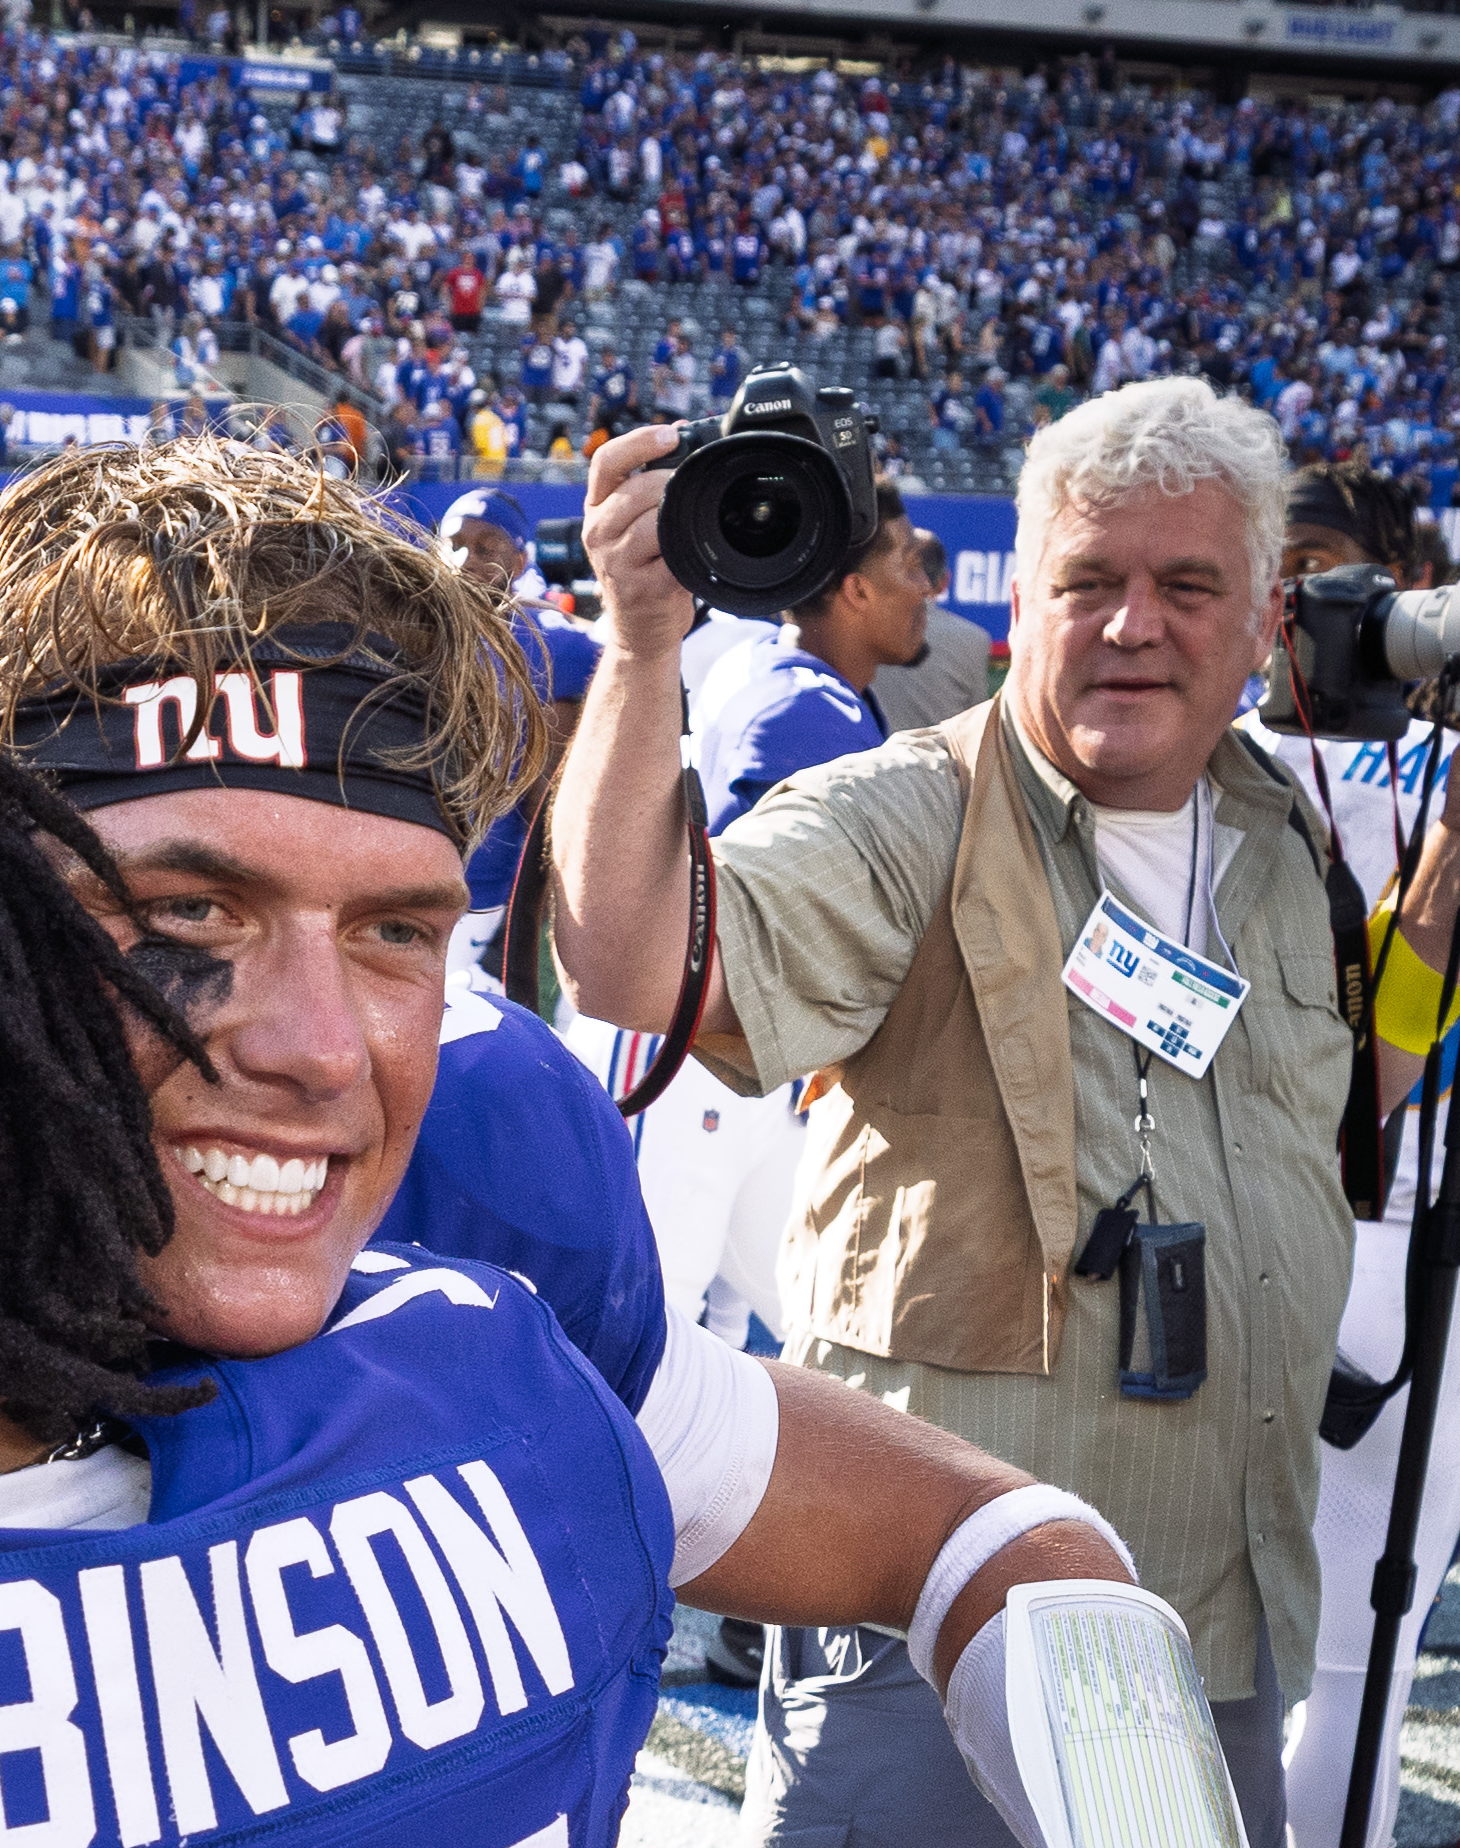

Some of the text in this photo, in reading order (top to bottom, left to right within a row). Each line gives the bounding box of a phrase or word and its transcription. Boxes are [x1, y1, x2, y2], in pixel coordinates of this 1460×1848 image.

[743, 399, 792, 417] Canon
[834, 416, 853, 429] EOS
[689, 863, 707, 973] Canon
